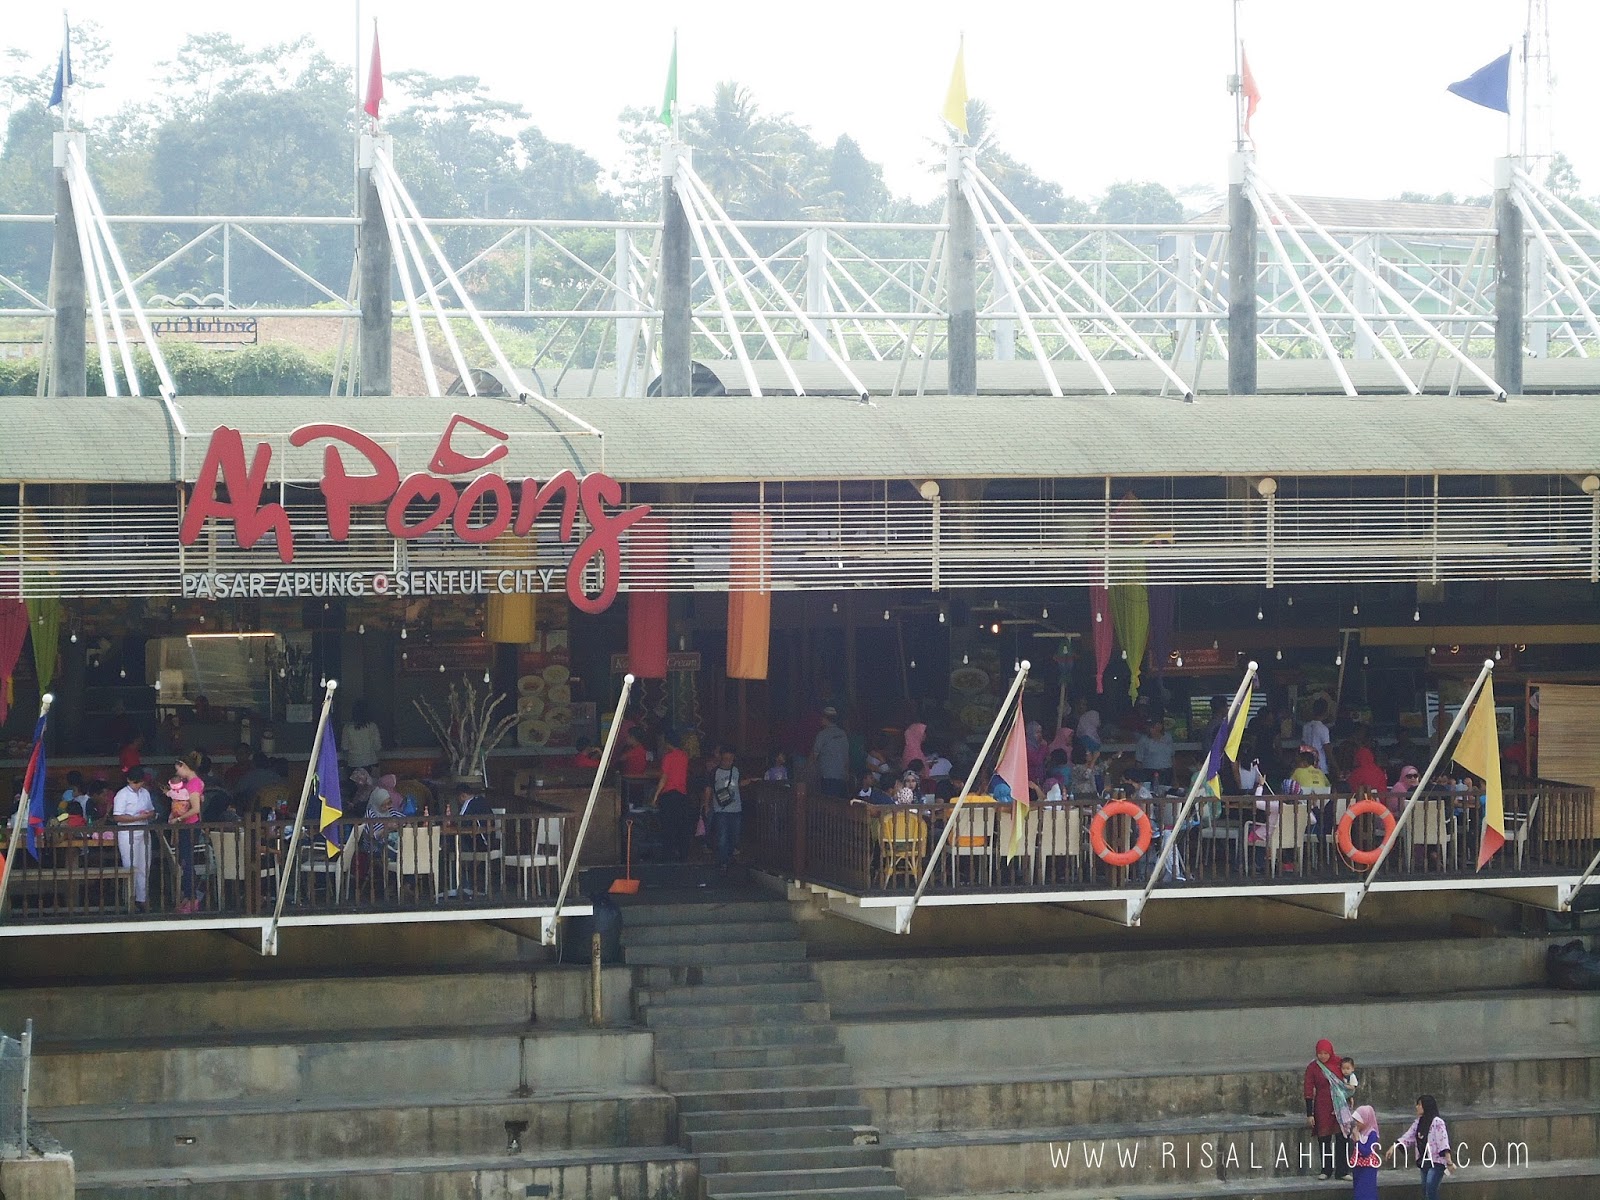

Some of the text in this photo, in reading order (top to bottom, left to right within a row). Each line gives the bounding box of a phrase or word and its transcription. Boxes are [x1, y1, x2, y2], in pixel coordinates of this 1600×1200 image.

[181, 425, 294, 564] Ah
[181, 573, 264, 598] PASAR
[275, 572, 366, 597] APUNG
[396, 570, 489, 596] SENTUL
[497, 568, 555, 593] CITY
